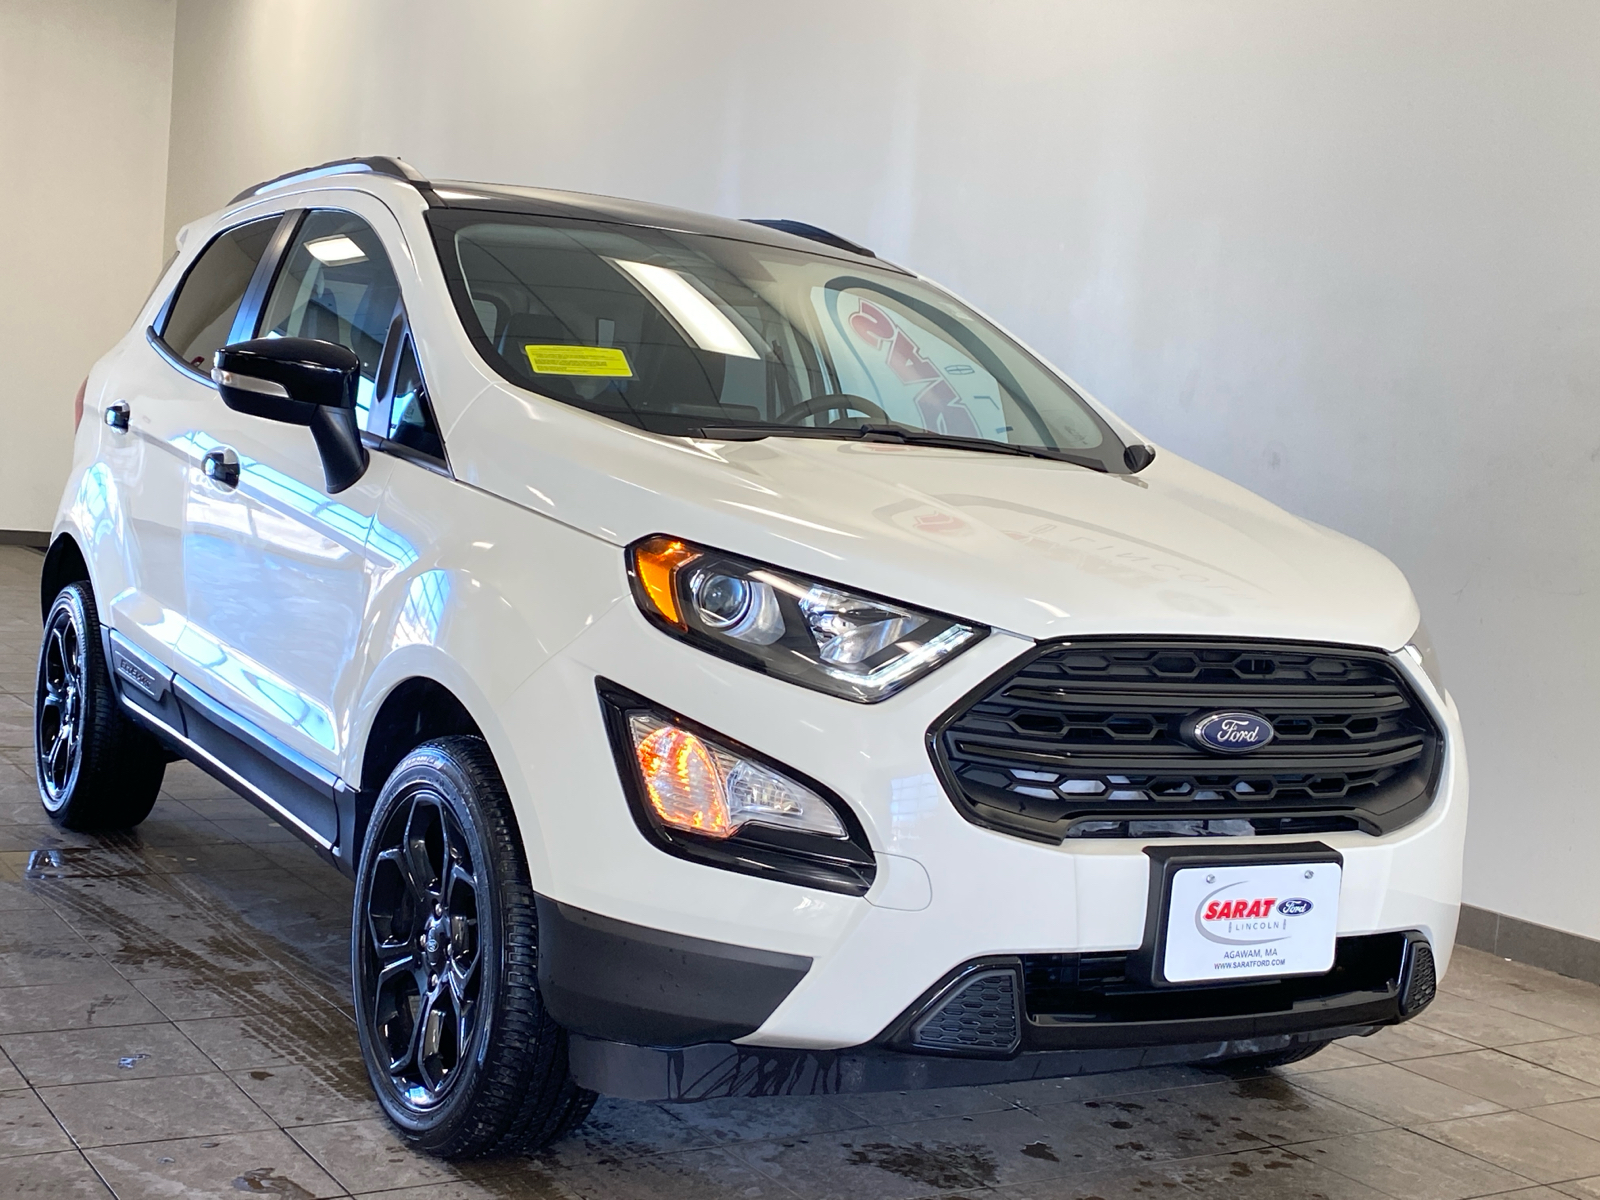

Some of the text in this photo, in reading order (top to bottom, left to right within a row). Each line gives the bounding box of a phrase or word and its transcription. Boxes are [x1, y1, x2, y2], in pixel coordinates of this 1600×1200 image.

[1217, 719, 1259, 743] Ford
[1203, 898, 1277, 921] SARAT
[1235, 921, 1280, 931] LINCOLN
[1223, 948, 1278, 959] AGAWAM, MA
[1214, 959, 1286, 970] WWW.SARATFORD.COM
